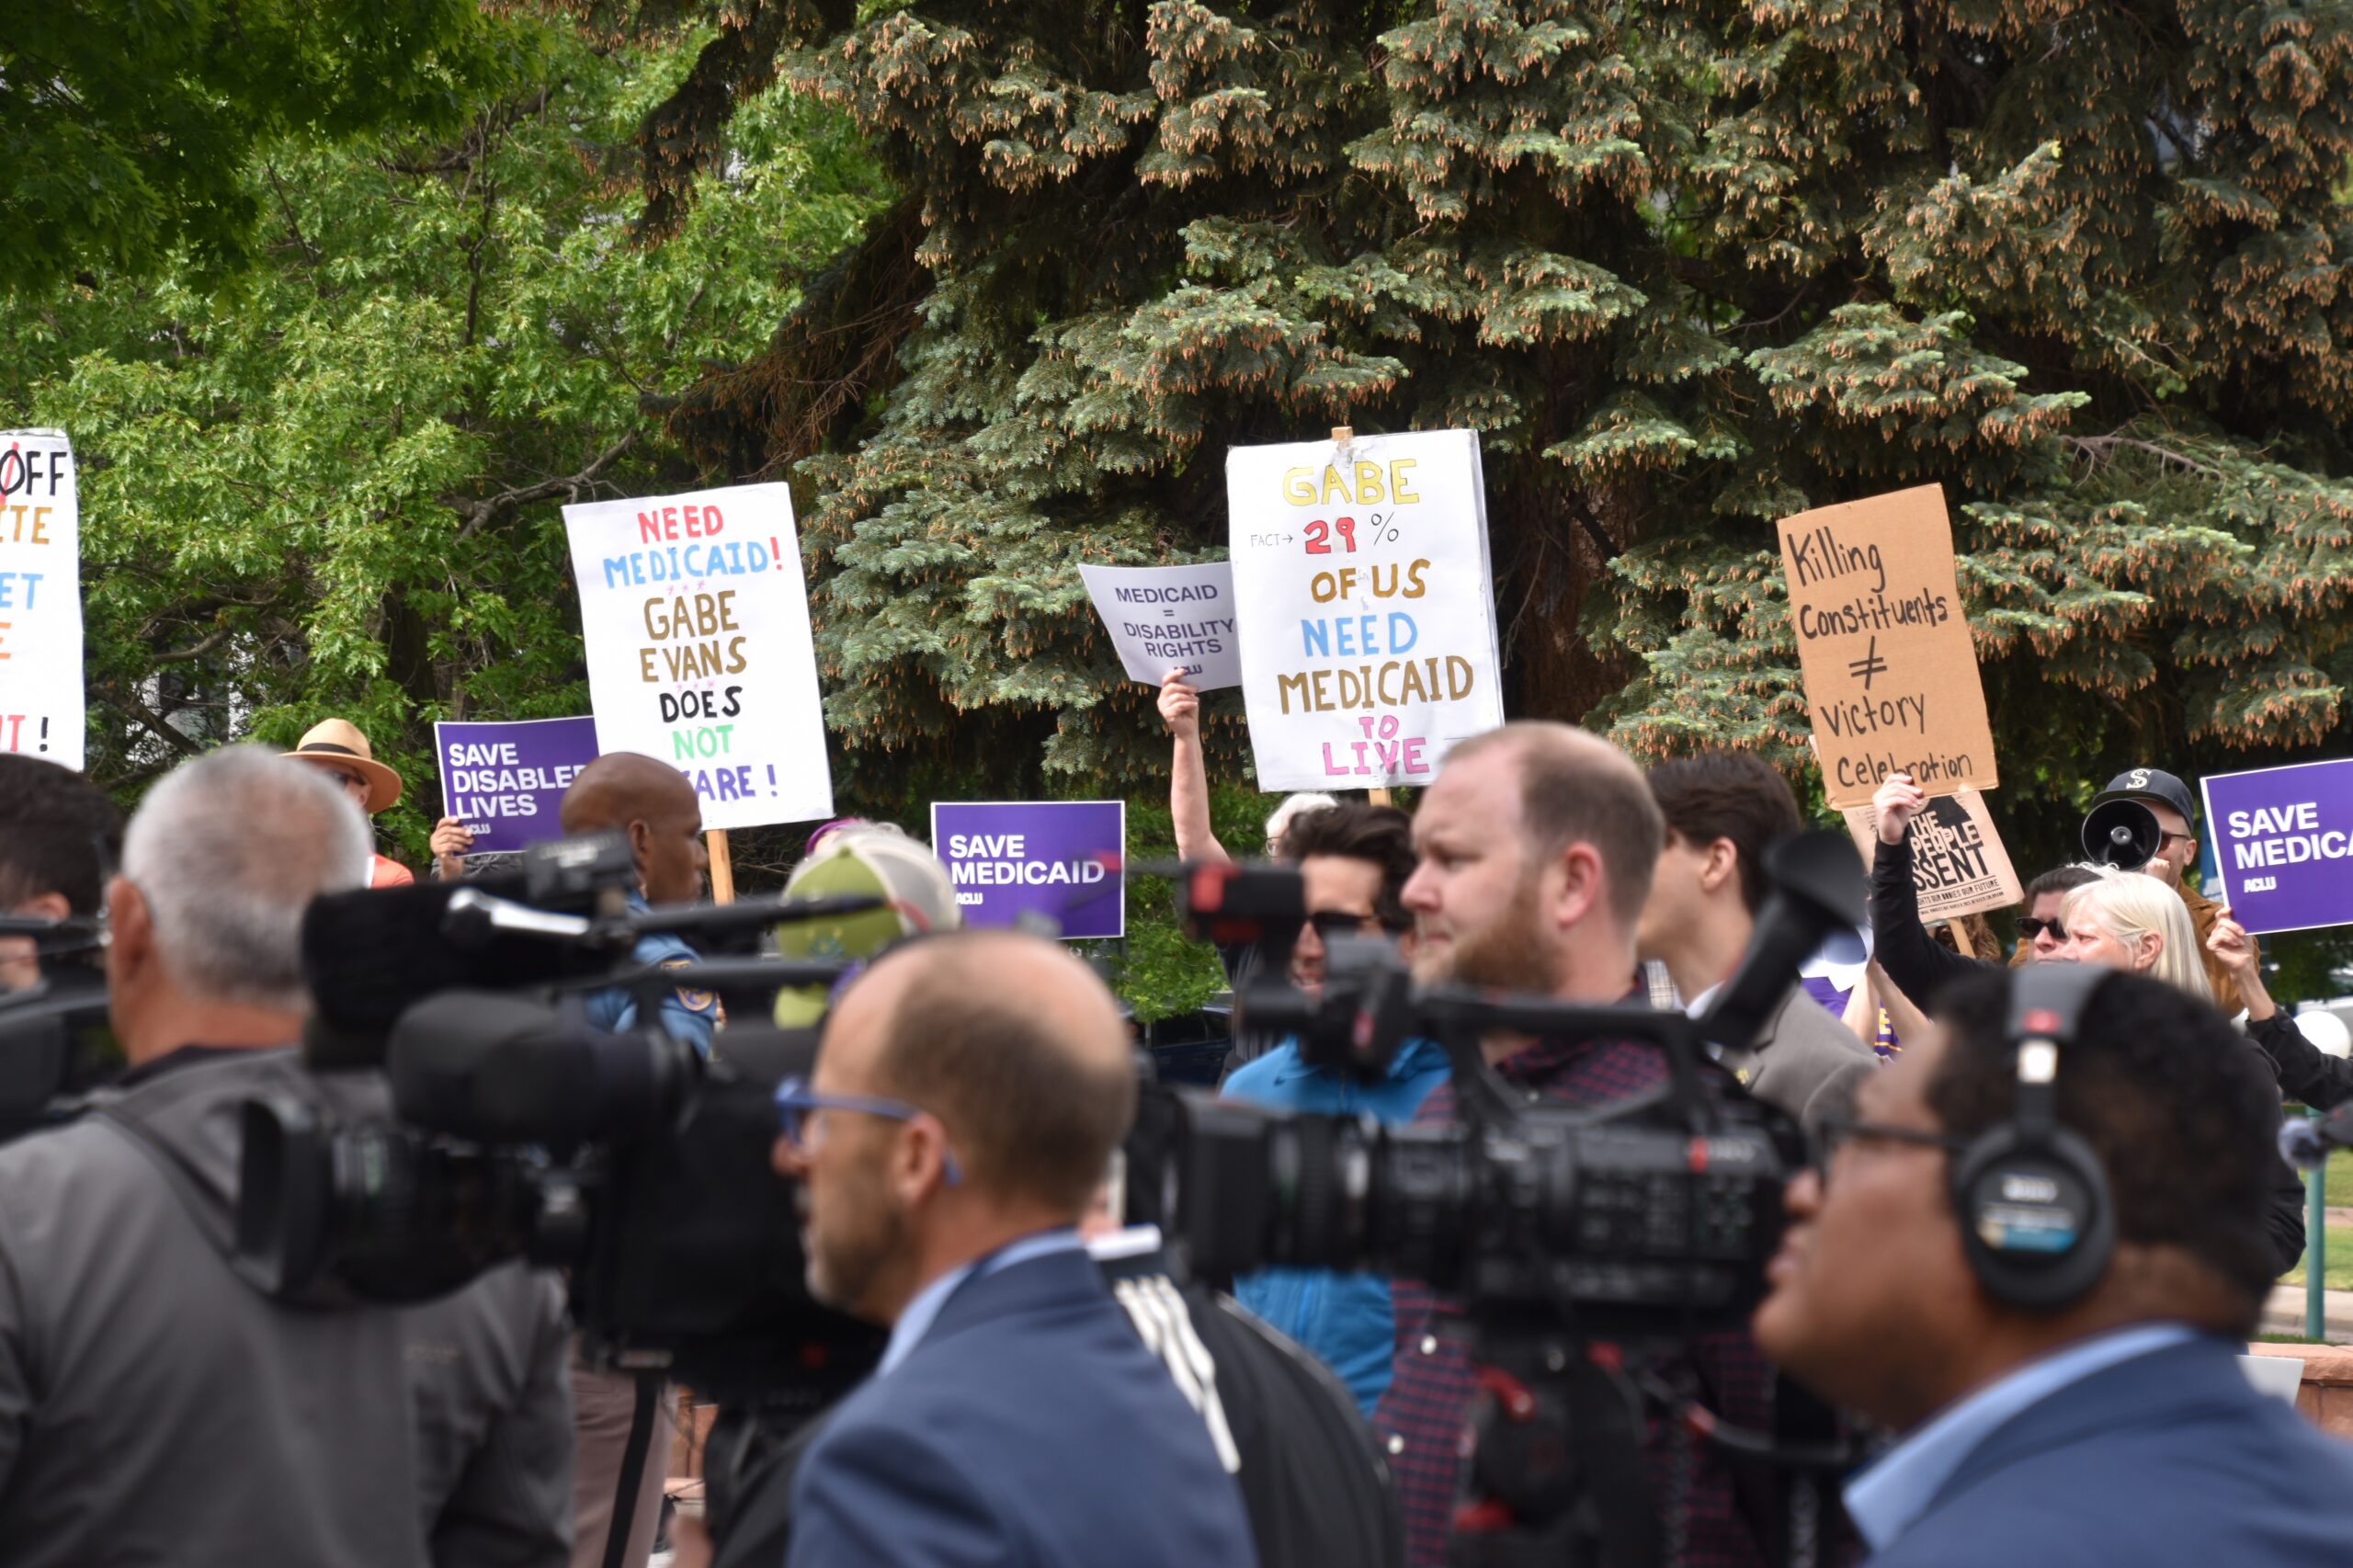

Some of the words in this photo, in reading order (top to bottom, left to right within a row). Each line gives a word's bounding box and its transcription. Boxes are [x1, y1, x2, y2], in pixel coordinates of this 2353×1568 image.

[1282, 459, 1420, 506] GABE
[637, 505, 724, 544] NEED
[1251, 533, 1280, 547] FACT
[1303, 517, 1357, 554] 29
[603, 536, 783, 588] MEDICAID!
[1787, 525, 1886, 593] Killing
[1115, 585, 1218, 603] MEDICAID
[1311, 567, 1358, 603] OF
[1371, 559, 1431, 599] US
[643, 590, 739, 641] GABE
[1123, 618, 1234, 640] DISABILITY
[1799, 587, 1949, 641] Constituents
[1144, 638, 1222, 658] RIGHTS
[1301, 611, 1418, 658] NEED
[640, 636, 747, 683] EVANS
[1277, 654, 1474, 715] MEDICAID
[659, 686, 744, 723] DOES
[672, 724, 734, 760] NOT
[1358, 715, 1400, 740] TO
[449, 743, 519, 767] SAVE
[1322, 736, 1430, 776] LIVE
[1837, 752, 1973, 788] Celebration
[680, 765, 756, 801] ARE
[456, 794, 538, 819] LIVES
[1910, 811, 1940, 837] THE
[2227, 801, 2320, 838] SAVE
[949, 835, 1025, 858] SAVE
[1910, 820, 1984, 860] PEOPLE
[2234, 830, 2353, 869] MEDIC
[951, 860, 1106, 885] MEDICAID
[2244, 876, 2277, 893] ACLU
[955, 892, 983, 905] ACLU
